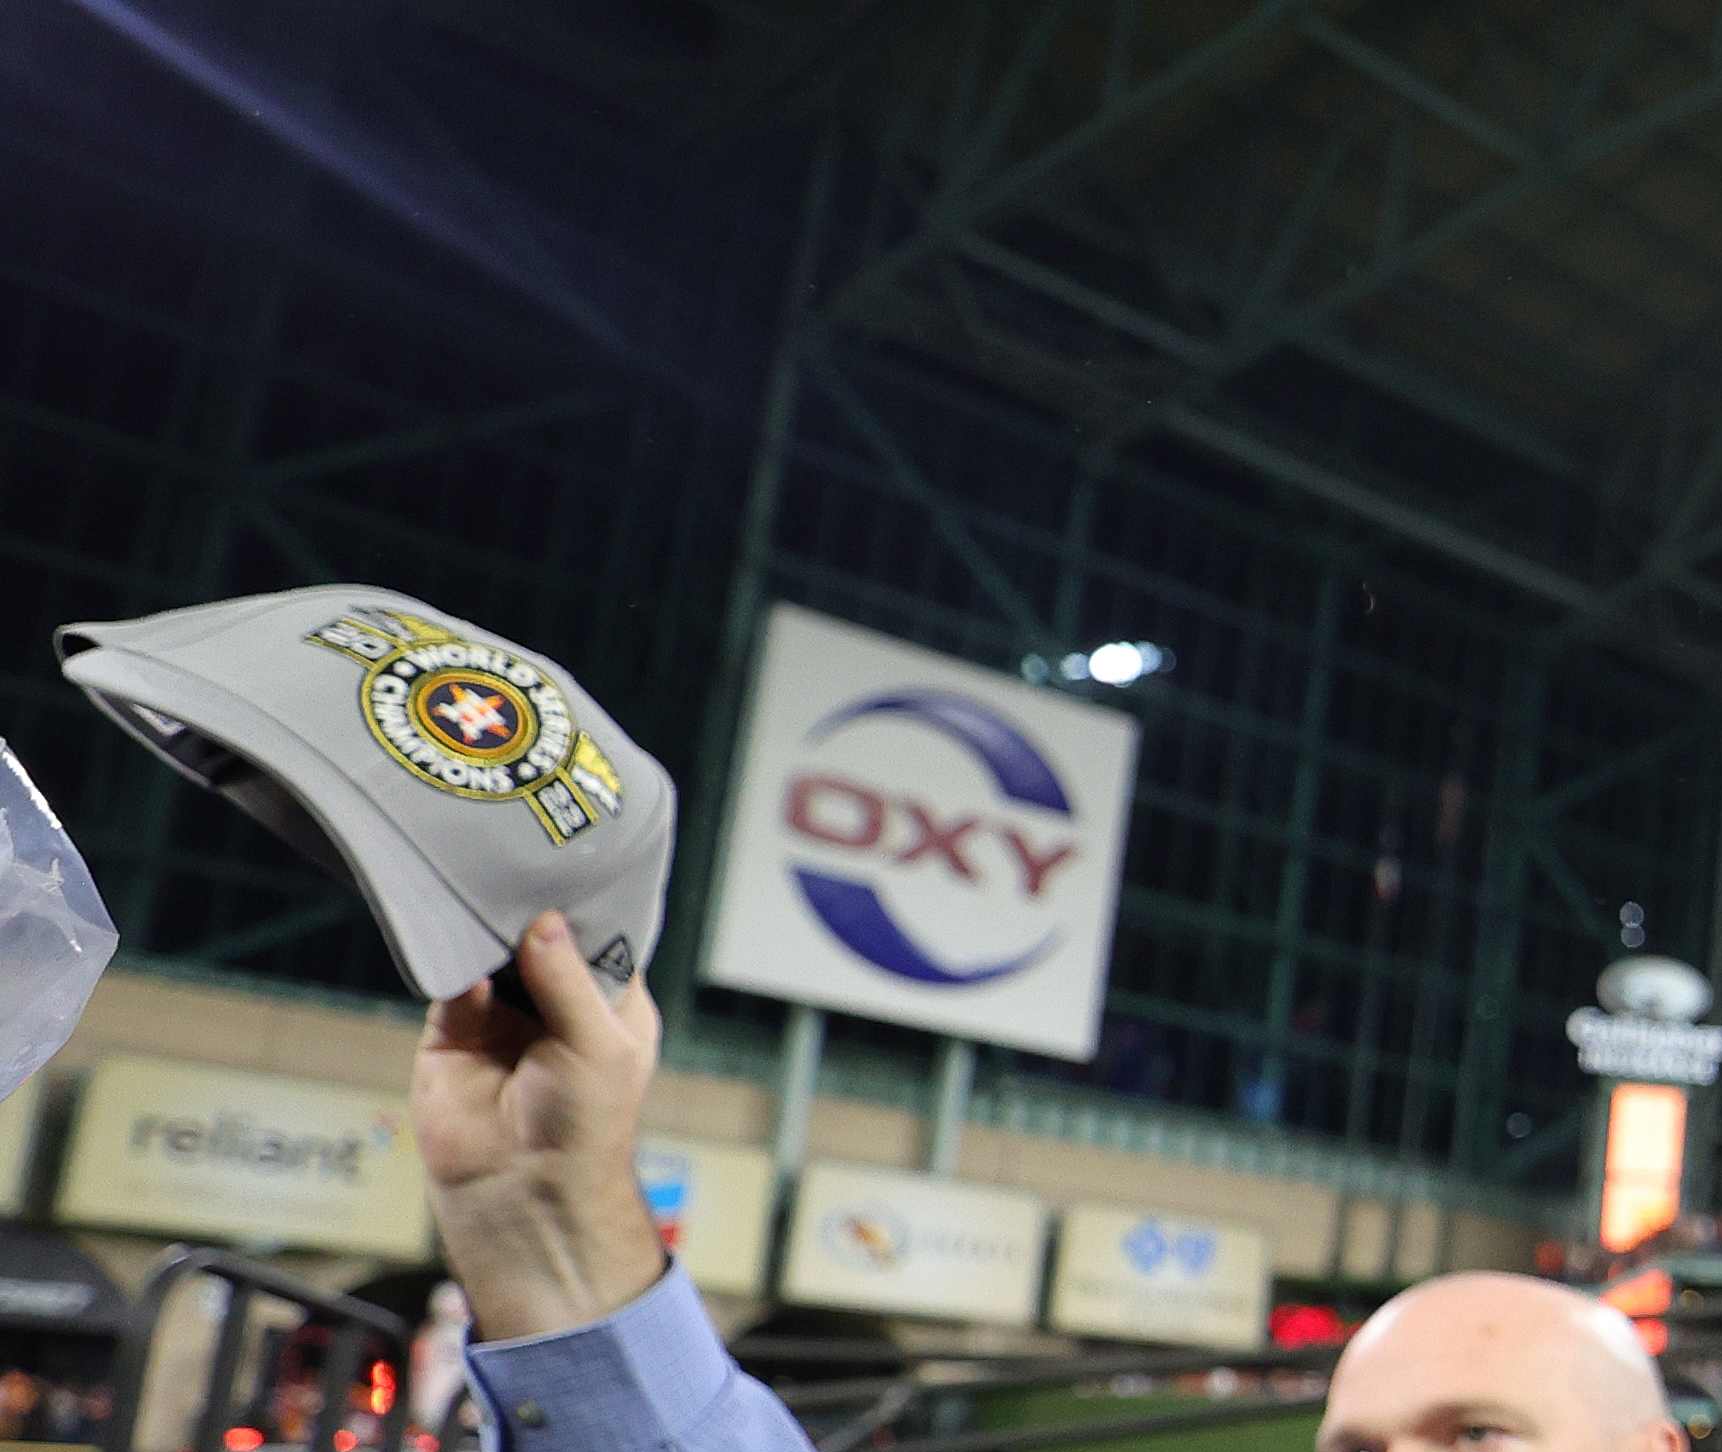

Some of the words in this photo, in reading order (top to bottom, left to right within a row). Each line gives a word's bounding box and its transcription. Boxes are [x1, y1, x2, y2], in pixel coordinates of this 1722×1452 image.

[402, 644, 537, 687] WORLD
[371, 674, 516, 793] CHAMPIONS
[784, 773, 1077, 897] OXY
[127, 1109, 367, 1182] reliant
